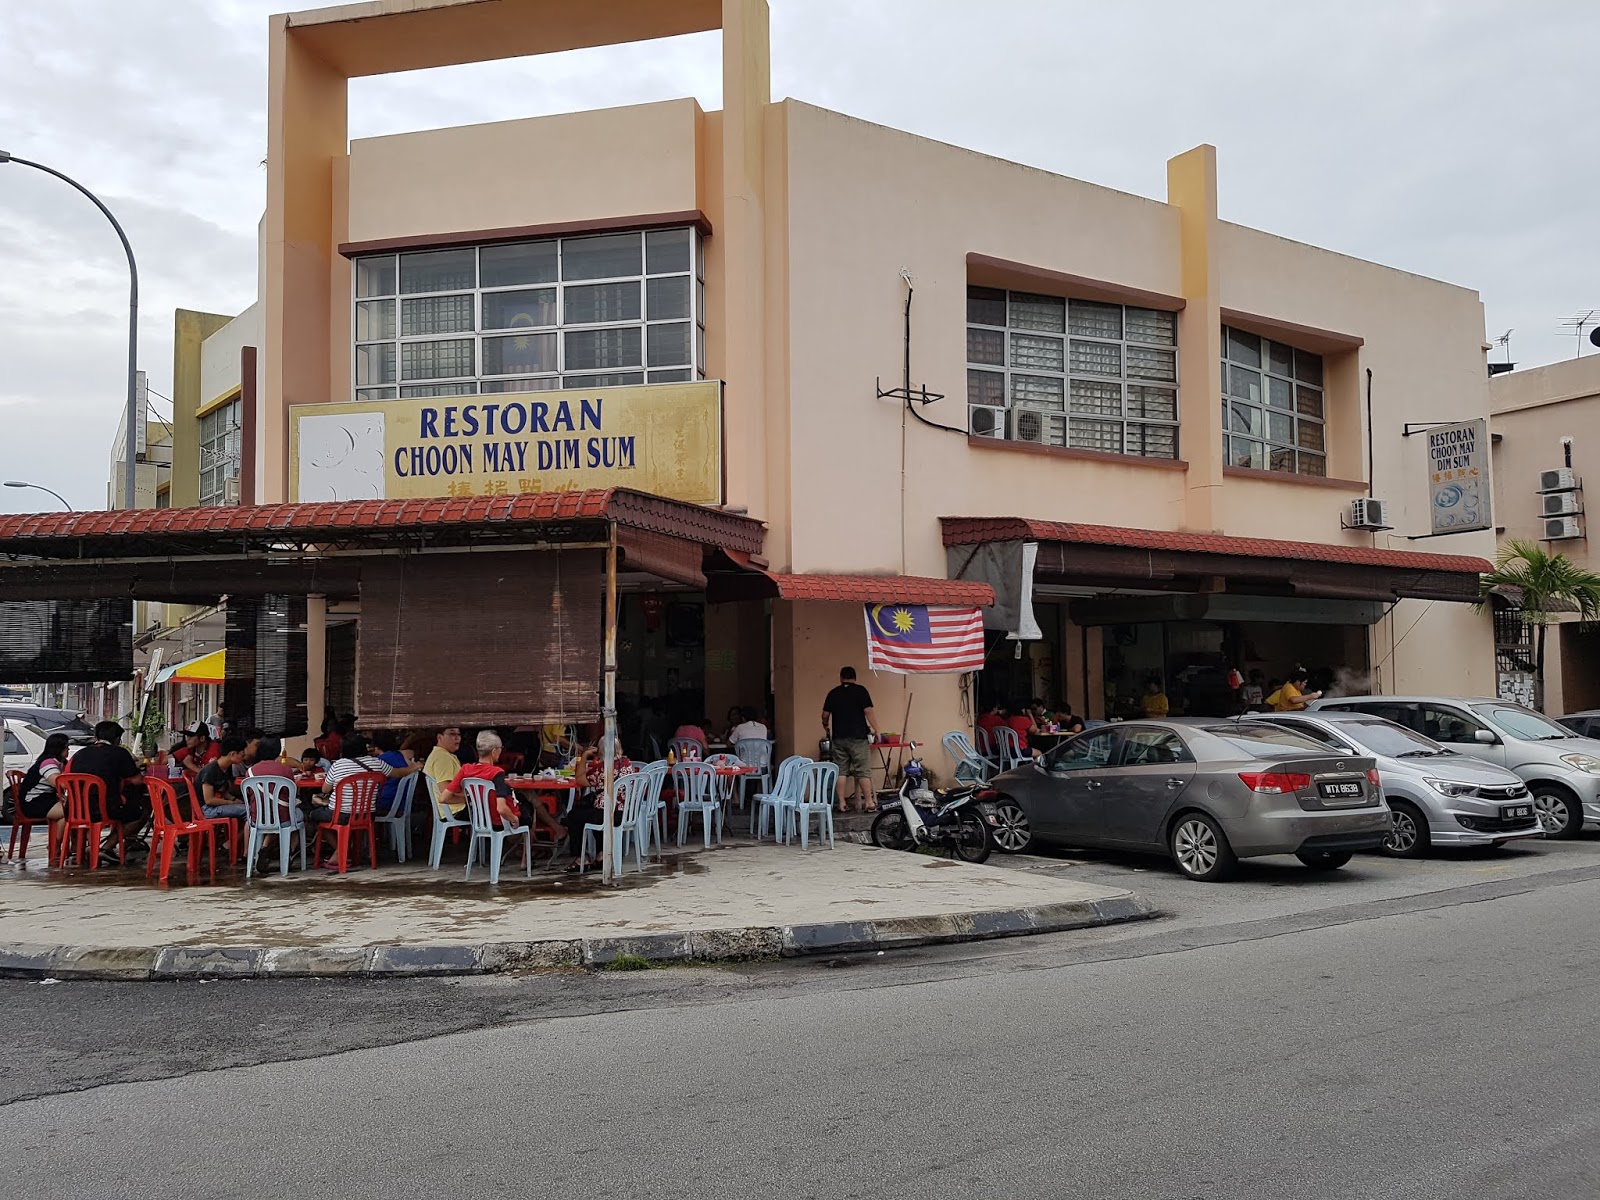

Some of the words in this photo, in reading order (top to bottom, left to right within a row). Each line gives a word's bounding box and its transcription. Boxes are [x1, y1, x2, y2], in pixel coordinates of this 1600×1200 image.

[420, 399, 602, 438] RESTORAN
[1430, 427, 1475, 447] RESTORAN
[394, 444, 473, 477] CHOON
[482, 441, 529, 473] MAY
[537, 438, 580, 471] DIM
[587, 436, 636, 468] SUM
[1431, 445, 1458, 460] CHOON
[1460, 441, 1475, 454] MAY
[1437, 459, 1452, 471] DIM
[1453, 455, 1470, 469] SUM
[1325, 784, 1340, 794] WTX
